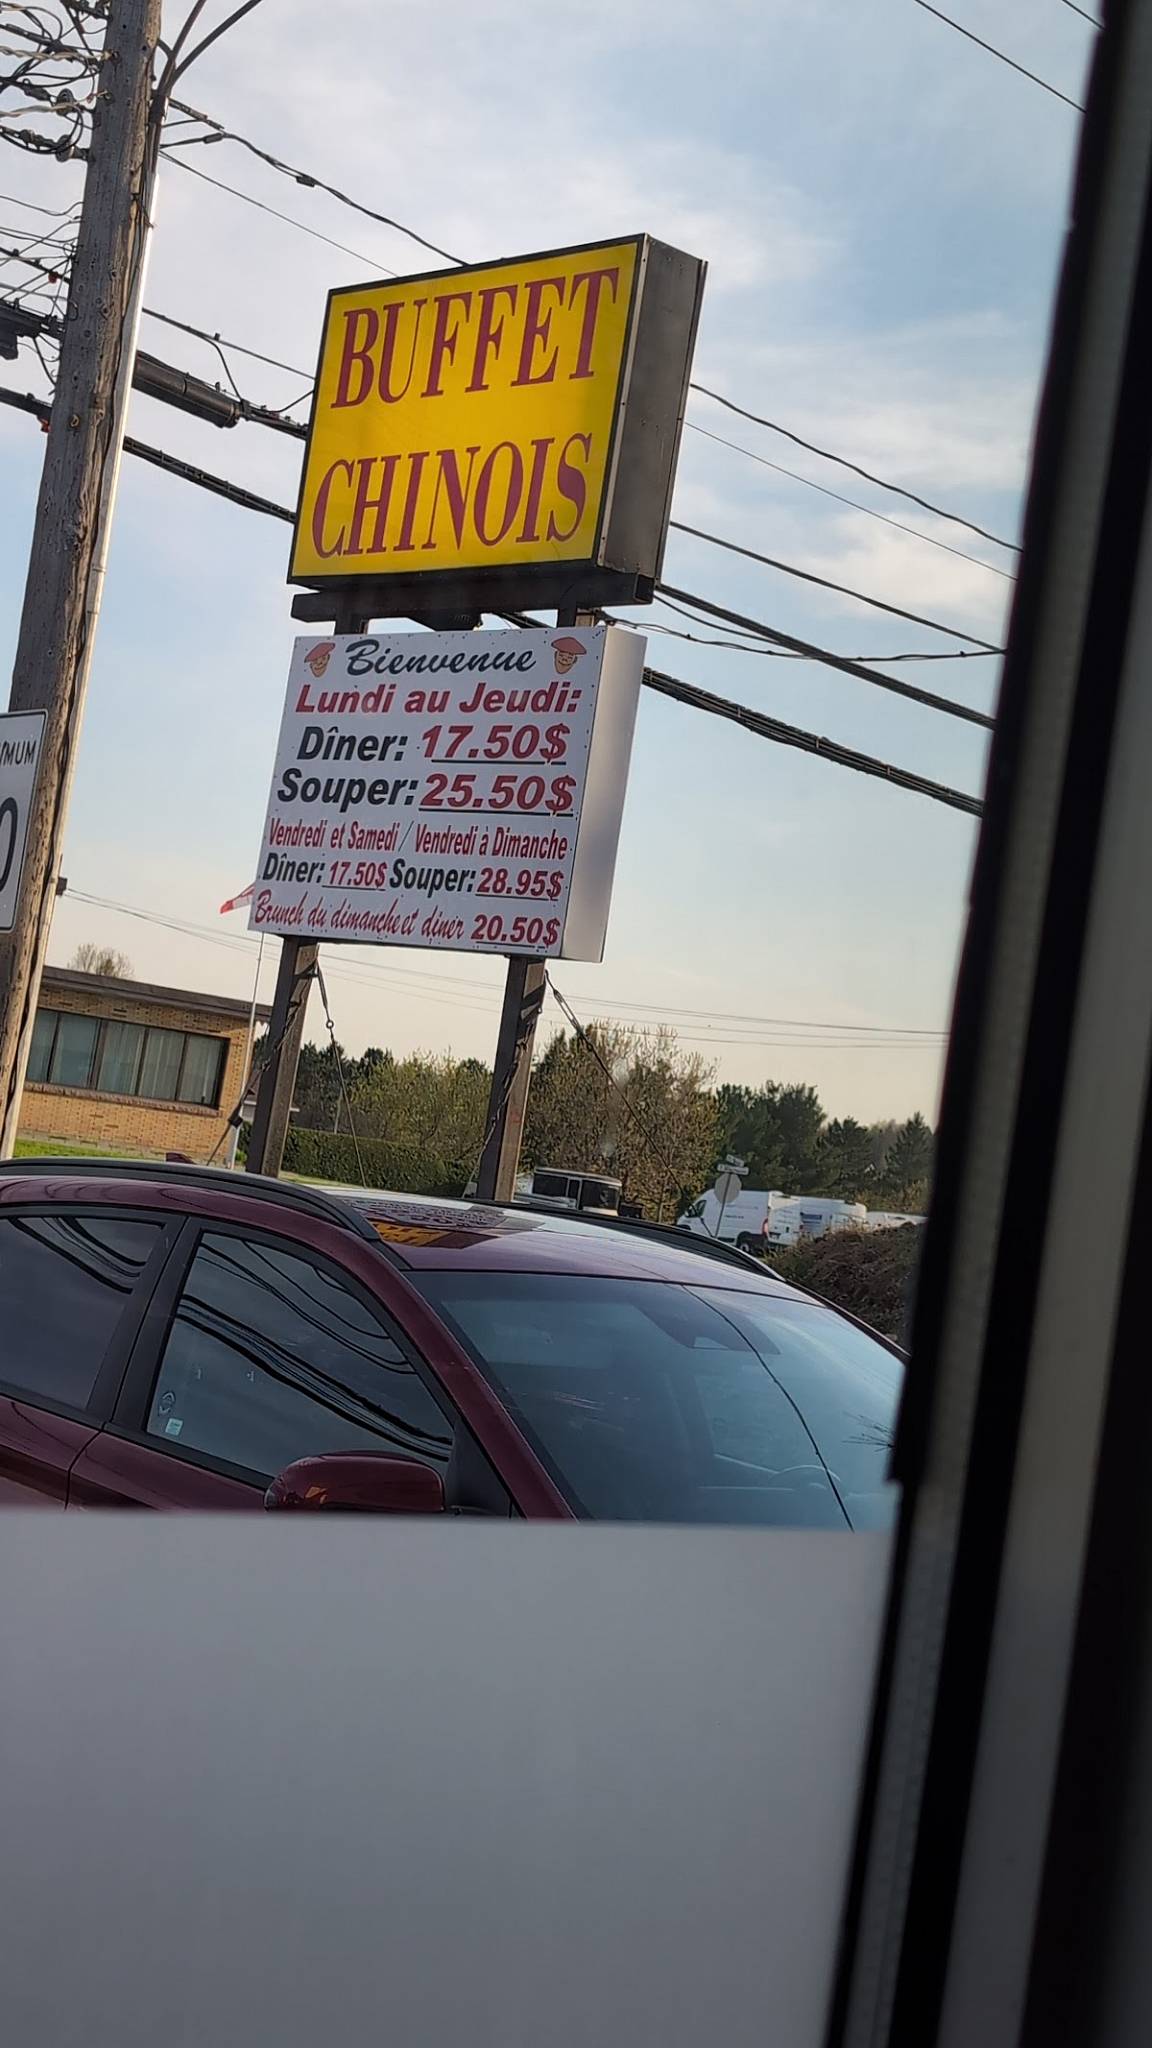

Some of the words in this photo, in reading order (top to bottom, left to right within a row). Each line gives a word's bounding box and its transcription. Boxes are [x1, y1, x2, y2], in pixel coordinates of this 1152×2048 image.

[330, 267, 620, 409] BUFFET
[311, 432, 593, 560] CHINOIS
[345, 638, 537, 676] Bienvenue
[295, 684, 397, 713] Lundi
[404, 690, 451, 713] au
[459, 681, 582, 713] Jeudi:
[0, 740, 37, 766] IMUM
[296, 725, 408, 762] Dîner:
[421, 722, 571, 765] 17.50$
[277, 767, 419, 813] Souper:
[419, 773, 577, 815] 25.50$
[269, 817, 328, 848] Vendredi
[330, 821, 346, 849] et
[348, 820, 401, 851] Samedi
[415, 823, 478, 856] Vendredi
[479, 825, 489, 856] à
[491, 826, 568, 860] Dimanche
[262, 852, 325, 883] Dîner:
[329, 860, 387, 888] 17.50$
[389, 857, 476, 898] Souper:
[476, 867, 564, 900] 28.95$
[254, 888, 308, 927] Brunch
[307, 895, 327, 928] du
[330, 897, 401, 935] dimanche
[400, 907, 420, 936] et
[471, 913, 561, 946] 20.50$
